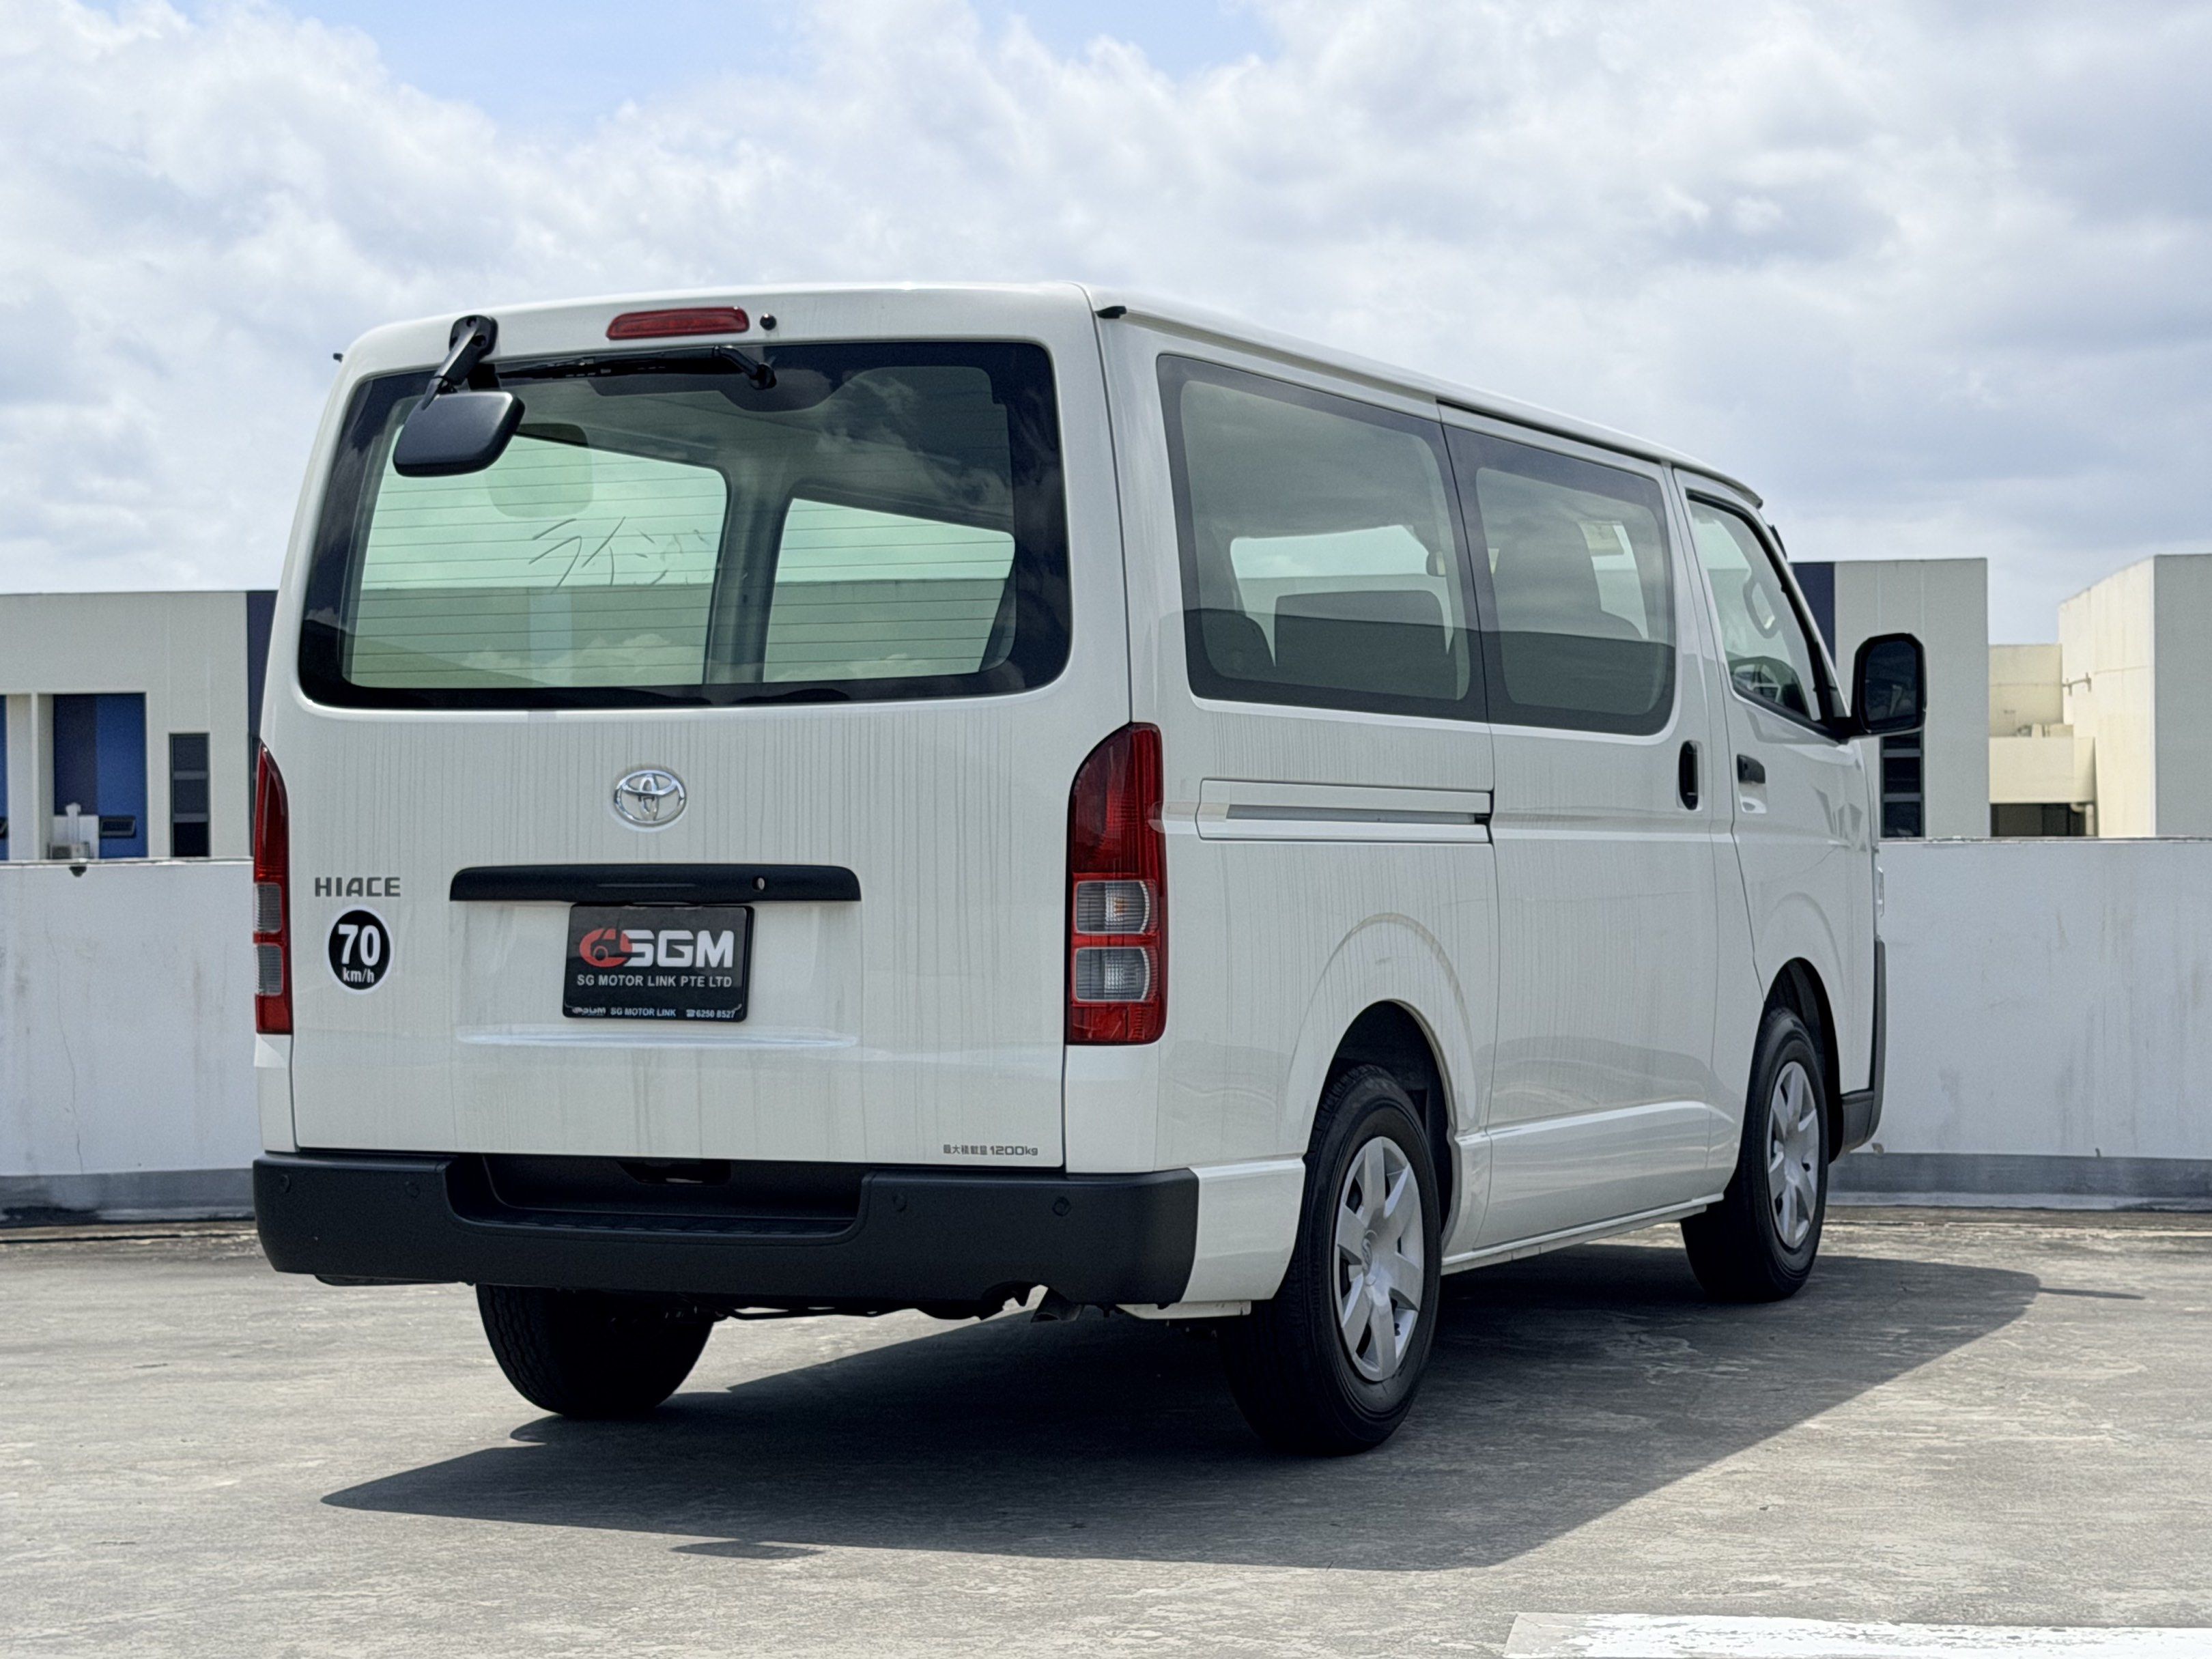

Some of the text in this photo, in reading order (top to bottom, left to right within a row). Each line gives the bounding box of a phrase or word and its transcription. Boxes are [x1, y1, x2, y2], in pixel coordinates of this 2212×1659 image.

[315, 877, 401, 897] HIACE
[338, 924, 381, 966] 70
[620, 929, 734, 967] SGM
[343, 966, 375, 983] km/h
[577, 974, 732, 987] SG MOTOR LINK PTE LTD
[990, 1146, 1038, 1156] 1200kg
